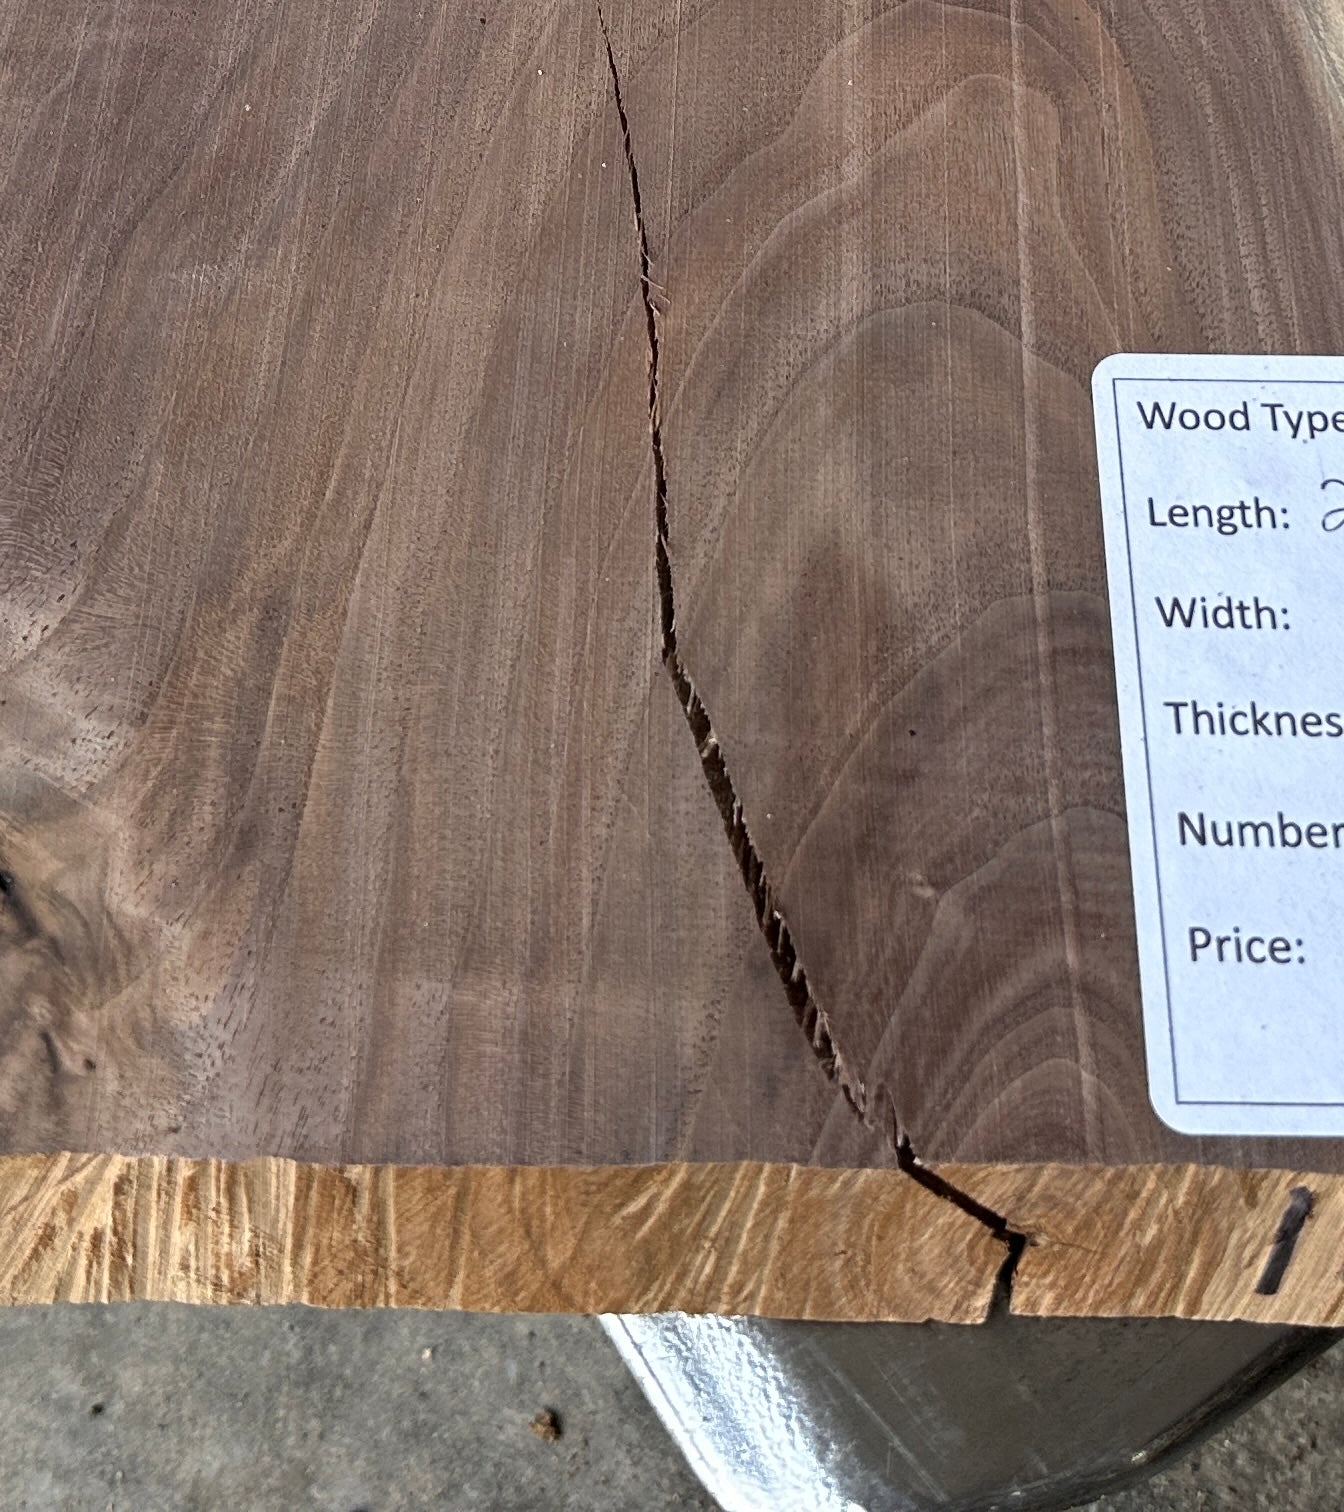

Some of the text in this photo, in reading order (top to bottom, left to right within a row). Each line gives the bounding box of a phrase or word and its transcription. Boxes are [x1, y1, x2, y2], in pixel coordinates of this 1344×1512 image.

[1135, 400, 1251, 434] Wood
[1147, 495, 1290, 538] Length:
[1154, 593, 1291, 632] Width:
[1188, 926, 1306, 965] Price:
